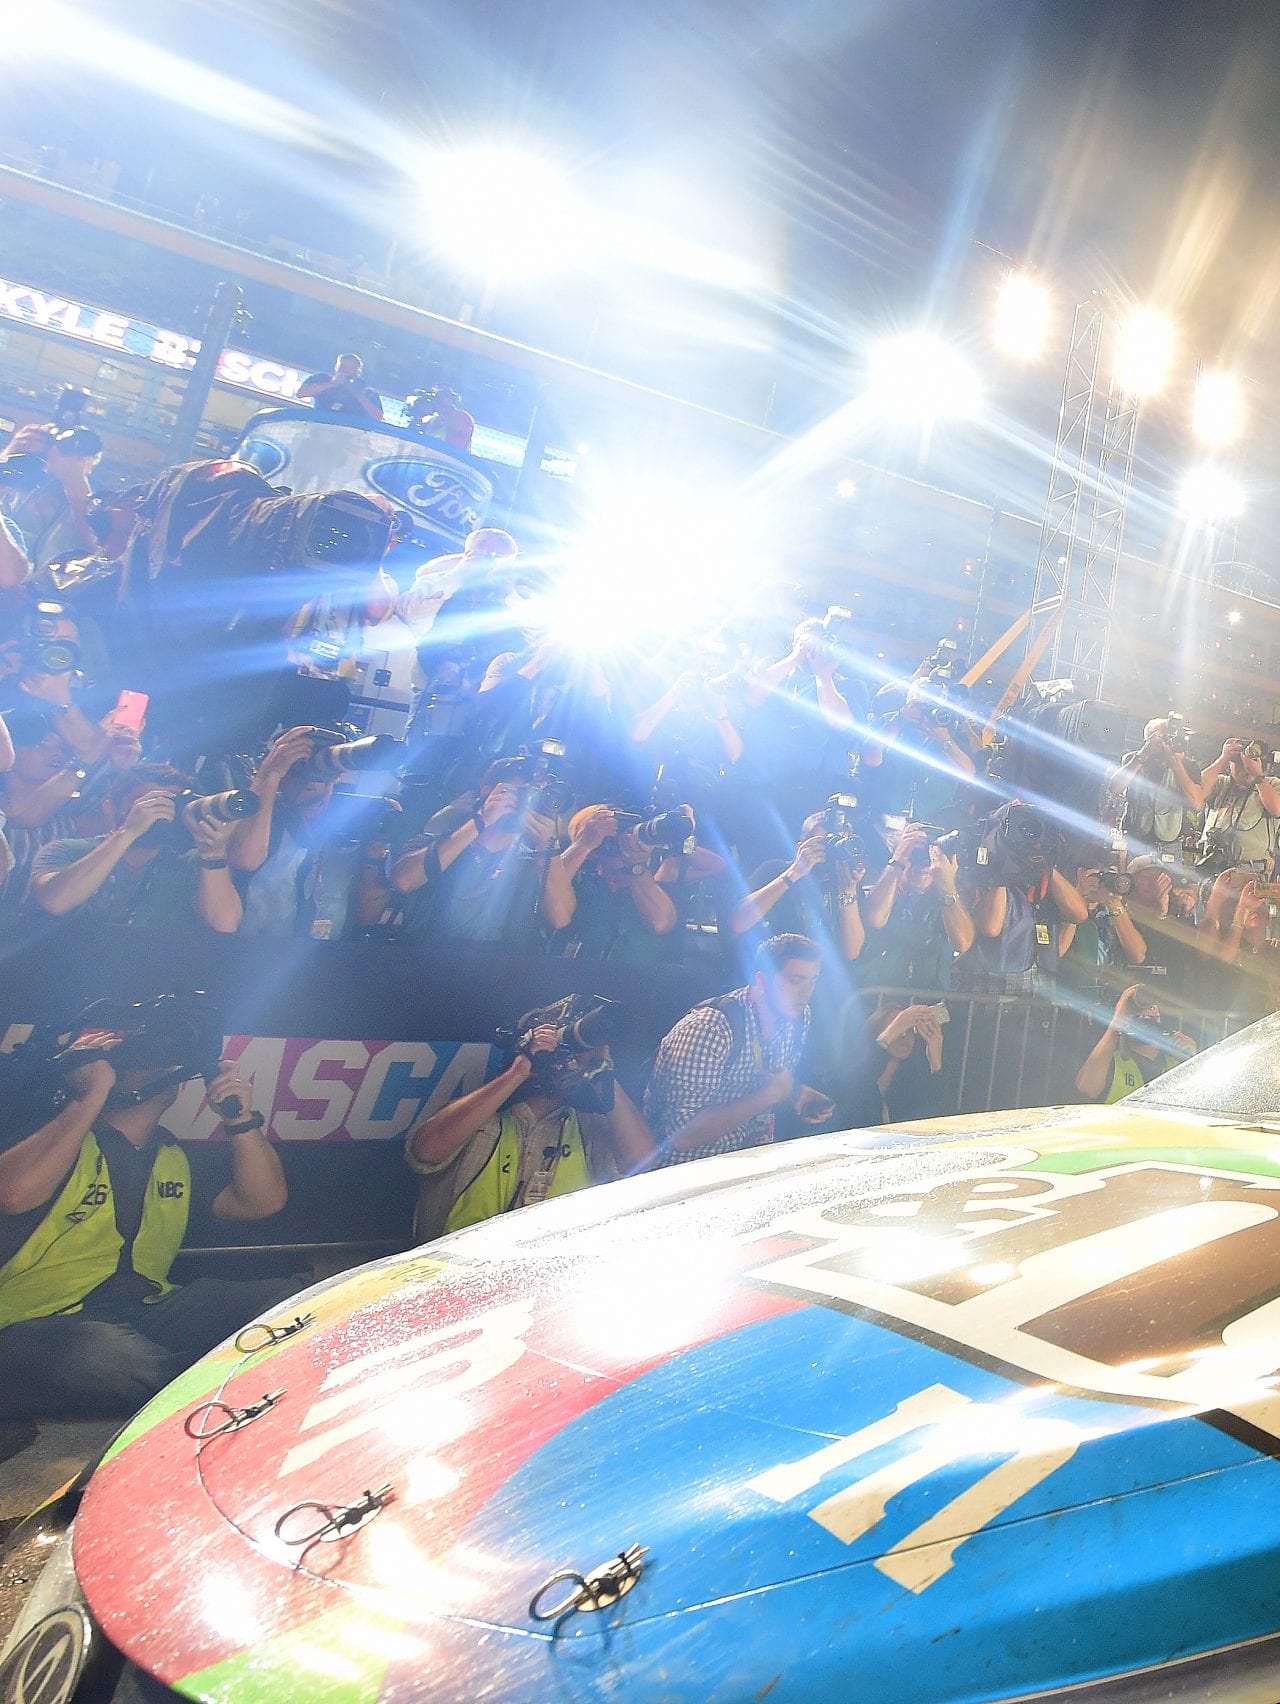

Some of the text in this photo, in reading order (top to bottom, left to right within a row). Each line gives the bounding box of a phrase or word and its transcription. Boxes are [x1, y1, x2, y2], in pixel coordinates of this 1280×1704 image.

[155, 1034, 494, 1141] ASCA
[1124, 1073, 1136, 1087] 16
[82, 1183, 109, 1206] 26
